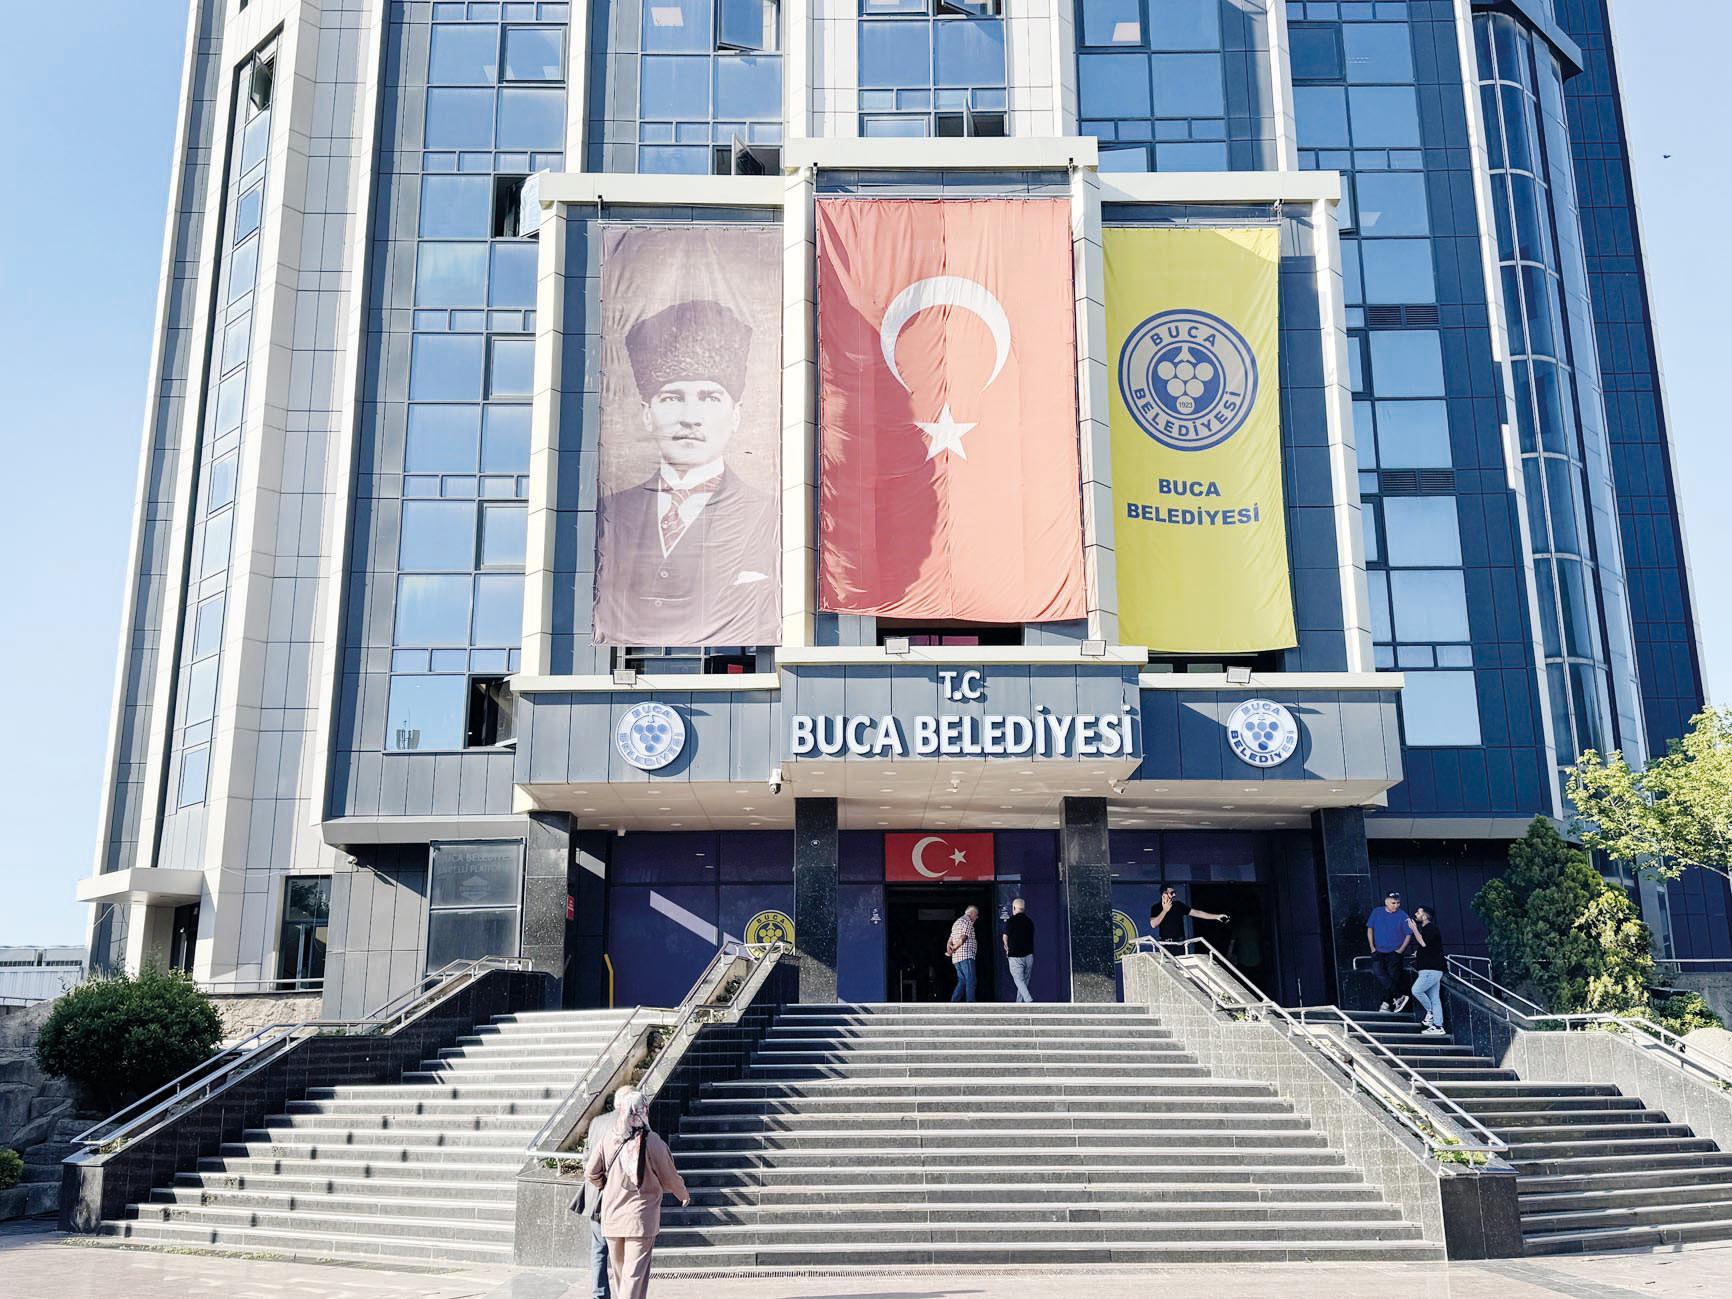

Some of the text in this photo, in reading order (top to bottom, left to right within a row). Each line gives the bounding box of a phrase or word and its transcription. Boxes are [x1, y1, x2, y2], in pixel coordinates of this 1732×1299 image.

[1150, 325, 1217, 347] BUCA
[1133, 388, 1241, 437] BELEDİYESİ
[1178, 401, 1193, 409] 1923
[1158, 478, 1221, 497] BUCA
[1127, 502, 1260, 526] BELEDİYESİ
[939, 670, 981, 701] T.C
[631, 705, 673, 719] BUCA
[1241, 702, 1281, 716] BUCA
[791, 704, 1134, 755] BUCA BELEDİYESİ
[756, 914, 785, 924] BUCA
